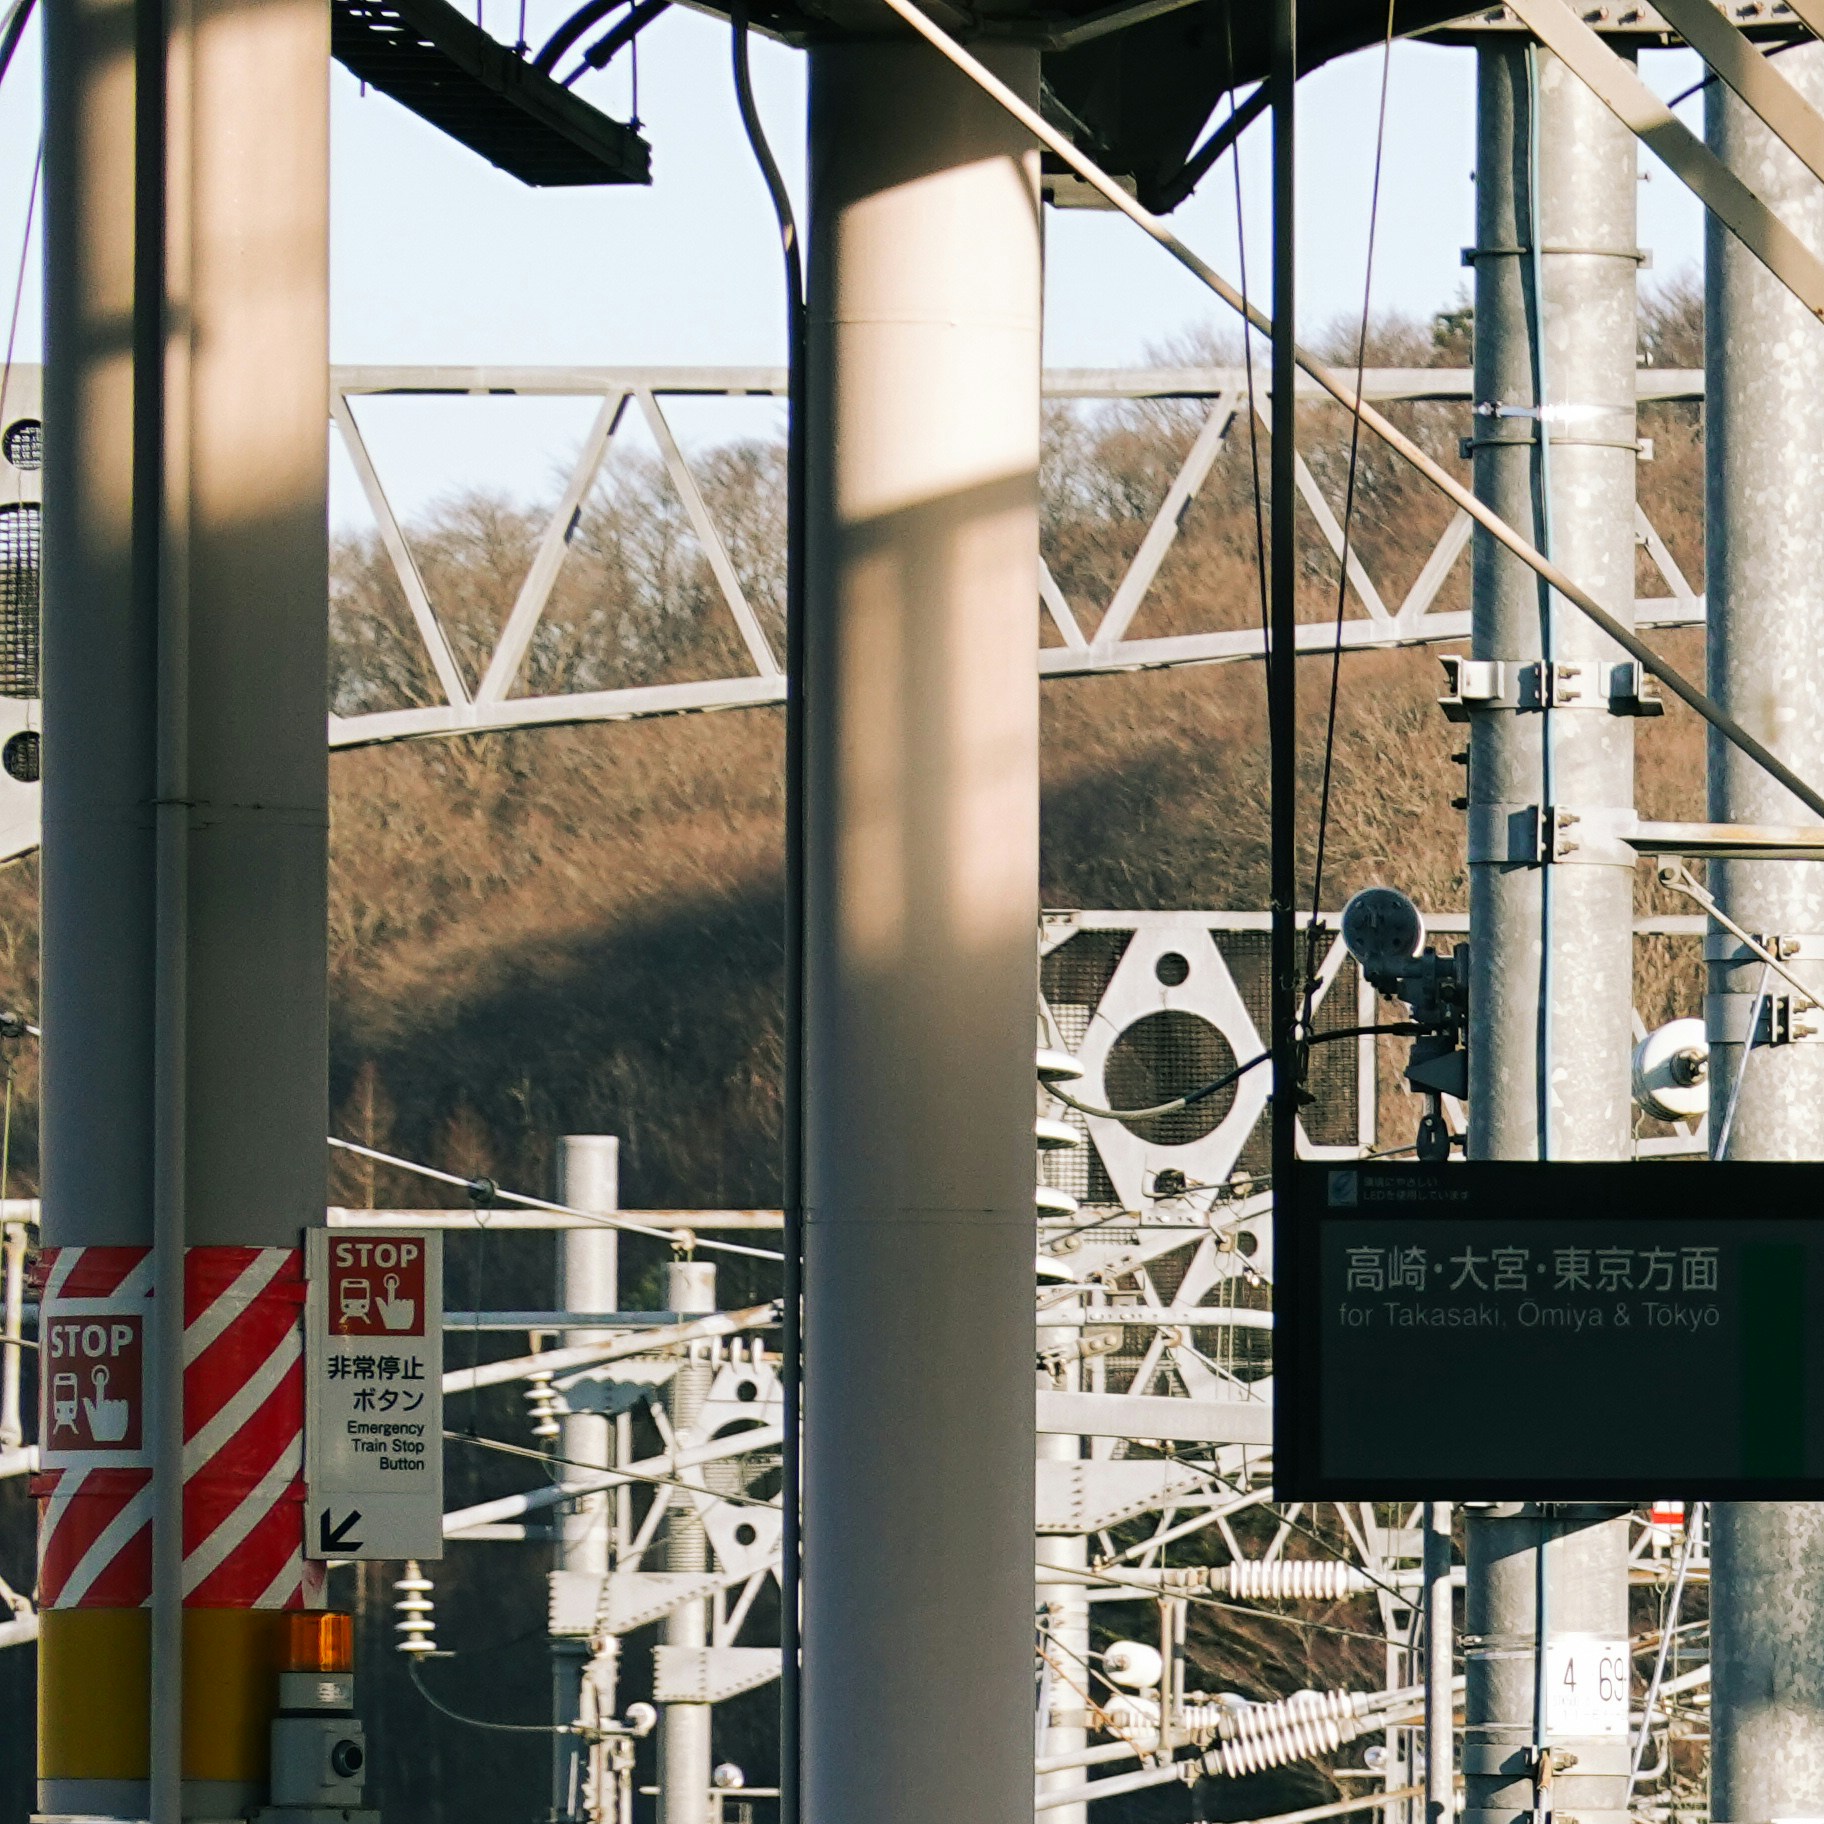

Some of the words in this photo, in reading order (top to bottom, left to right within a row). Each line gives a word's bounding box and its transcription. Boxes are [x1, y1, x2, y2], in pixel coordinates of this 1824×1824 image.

[335, 1242, 419, 1269] STOP
[1345, 1246, 1720, 1293] 高崎・大宮・東京方面
[1339, 1302, 1373, 1326] for
[1387, 1302, 1507, 1330] Takasaki,
[1518, 1297, 1604, 1332] Ōmiya
[1613, 1304, 1631, 1326] &
[1643, 1301, 1720, 1332] Tōkyō
[50, 1324, 134, 1359] STOP
[326, 1355, 426, 1381] 非常停止
[352, 1388, 425, 1413] ボタン
[347, 1420, 425, 1439] Emergency
[352, 1438, 386, 1453] Train
[392, 1438, 425, 1456] Stop
[379, 1456, 425, 1471] Button
